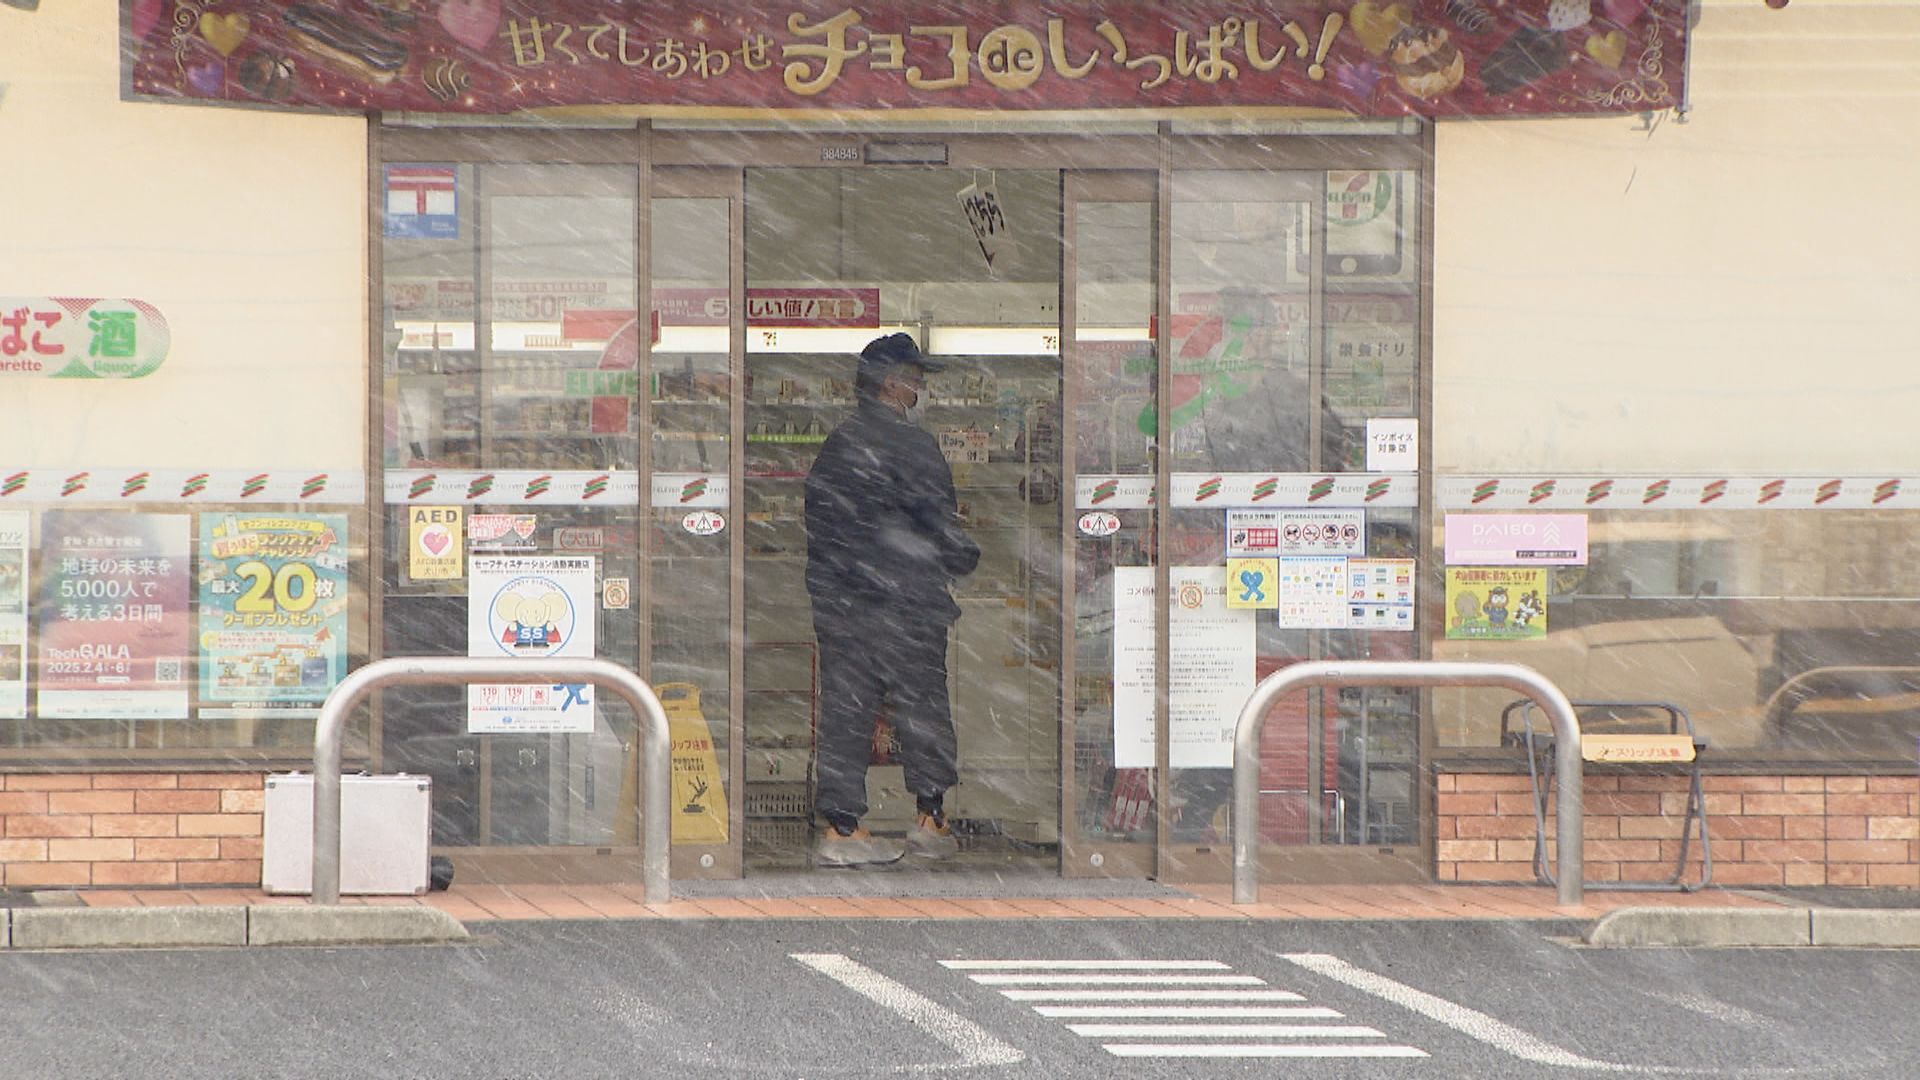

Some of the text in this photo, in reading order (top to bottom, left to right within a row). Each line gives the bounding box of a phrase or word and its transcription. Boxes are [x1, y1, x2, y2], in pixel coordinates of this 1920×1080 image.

[500, 15, 774, 79] 甘くてしあわせ
[0, 307, 137, 357] ばこ 酒
[1372, 433, 1413, 441] インボイス
[1378, 444, 1407, 453] 対象店
[415, 510, 457, 522] AED
[1472, 522, 1536, 537] DAISO
[61, 558, 172, 576] 地球の未来を
[474, 559, 590, 570] セーフティステーション活動実施店
[60, 604, 163, 623] 考える3日間
[223, 614, 324, 628] クーポンプレゼント
[520, 627, 543, 639] SS
[48, 644, 130, 660] TechGALA
[482, 687, 497, 697] 110
[507, 687, 522, 697] 119
